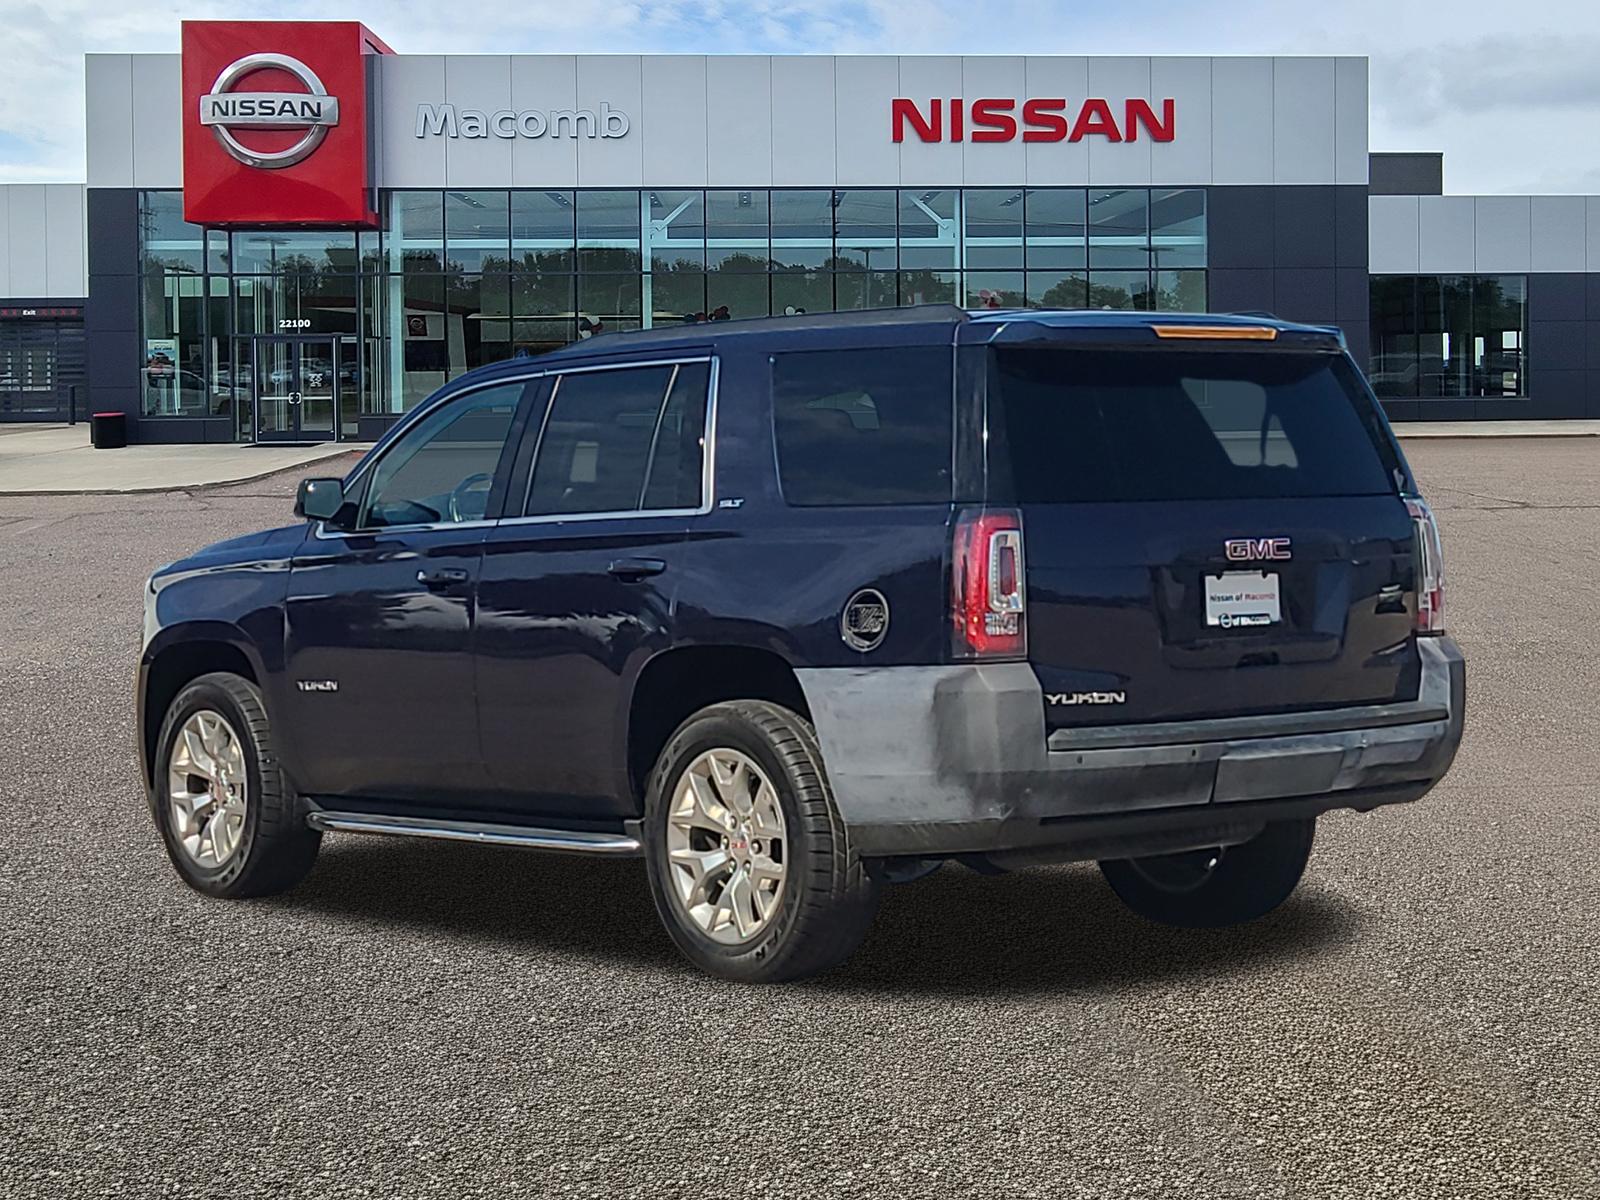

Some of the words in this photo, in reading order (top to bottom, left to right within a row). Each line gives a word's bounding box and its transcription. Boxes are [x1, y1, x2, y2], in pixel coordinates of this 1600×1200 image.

[211, 100, 322, 118] NISSAN
[415, 101, 630, 139] Macomb
[892, 98, 1176, 143] NISSAN
[279, 319, 311, 328] 22100
[719, 498, 744, 508] SLT
[1225, 538, 1292, 561] GMC
[1210, 594, 1234, 602] Nissan
[1235, 593, 1243, 601] of
[296, 680, 338, 691] YUKON
[1044, 691, 1126, 705] YUKON
